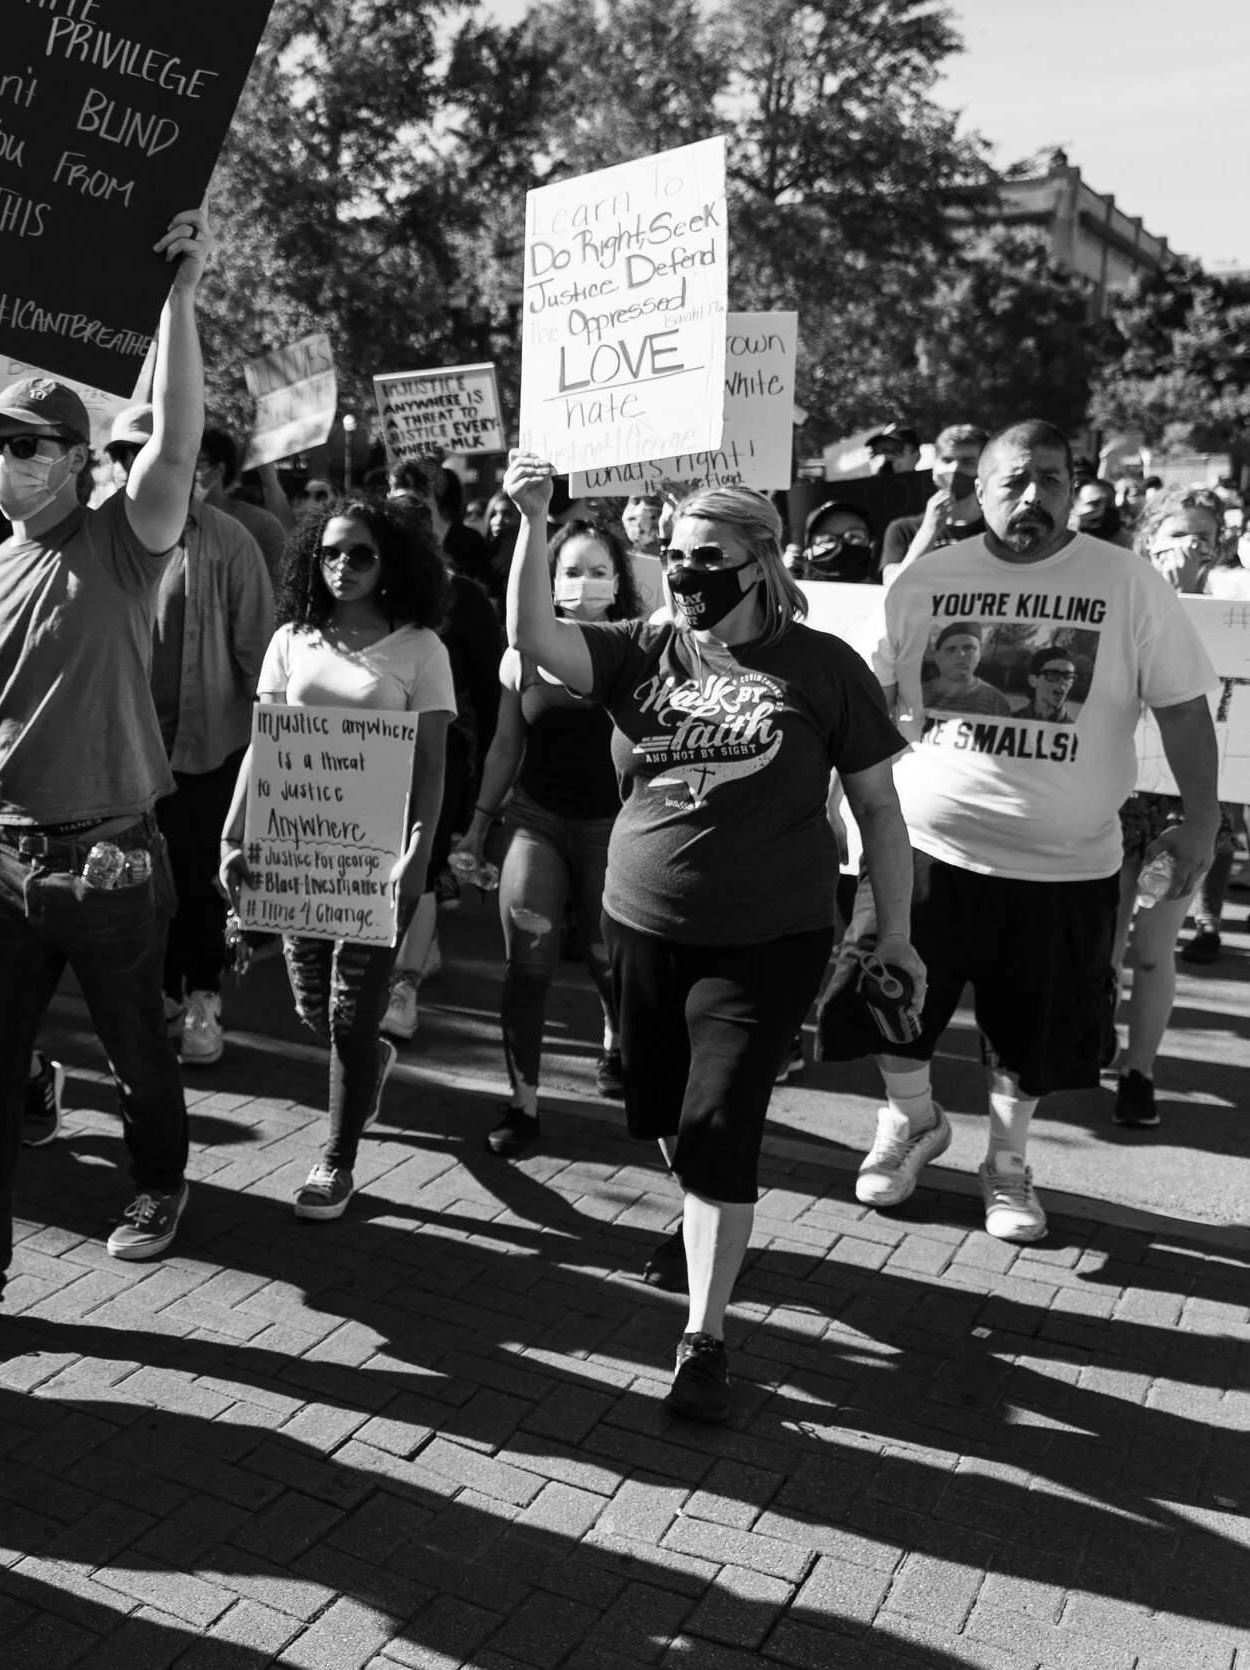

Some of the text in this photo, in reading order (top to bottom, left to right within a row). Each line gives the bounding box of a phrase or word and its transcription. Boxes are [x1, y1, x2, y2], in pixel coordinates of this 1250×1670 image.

[46, 16, 220, 98] PRIVILEGE
[76, 88, 180, 157] BLIND
[53, 151, 135, 209] FROM
[533, 156, 684, 237] Learn To
[530, 242, 571, 277] Do
[649, 201, 720, 245] Seek
[527, 238, 716, 314] Justice Defend
[568, 276, 686, 346] Oppressed
[558, 328, 685, 393] LOVE
[725, 333, 786, 356] rown
[383, 389, 484, 415] ANYWHERE IS
[386, 406, 478, 430] A THREAT TO
[565, 392, 647, 429] hate
[387, 424, 448, 445] JUSTICE
[931, 592, 1107, 625] YOU'RE KILLING
[736, 686, 767, 703] BY
[341, 717, 416, 742] anywhere
[954, 720, 1079, 763] SMALLS!
[303, 753, 313, 771] a
[321, 752, 366, 772] threat
[646, 744, 757, 764] AND NOT BY SIGHT
[257, 778, 271, 798] to
[267, 808, 367, 850] Anywhere
